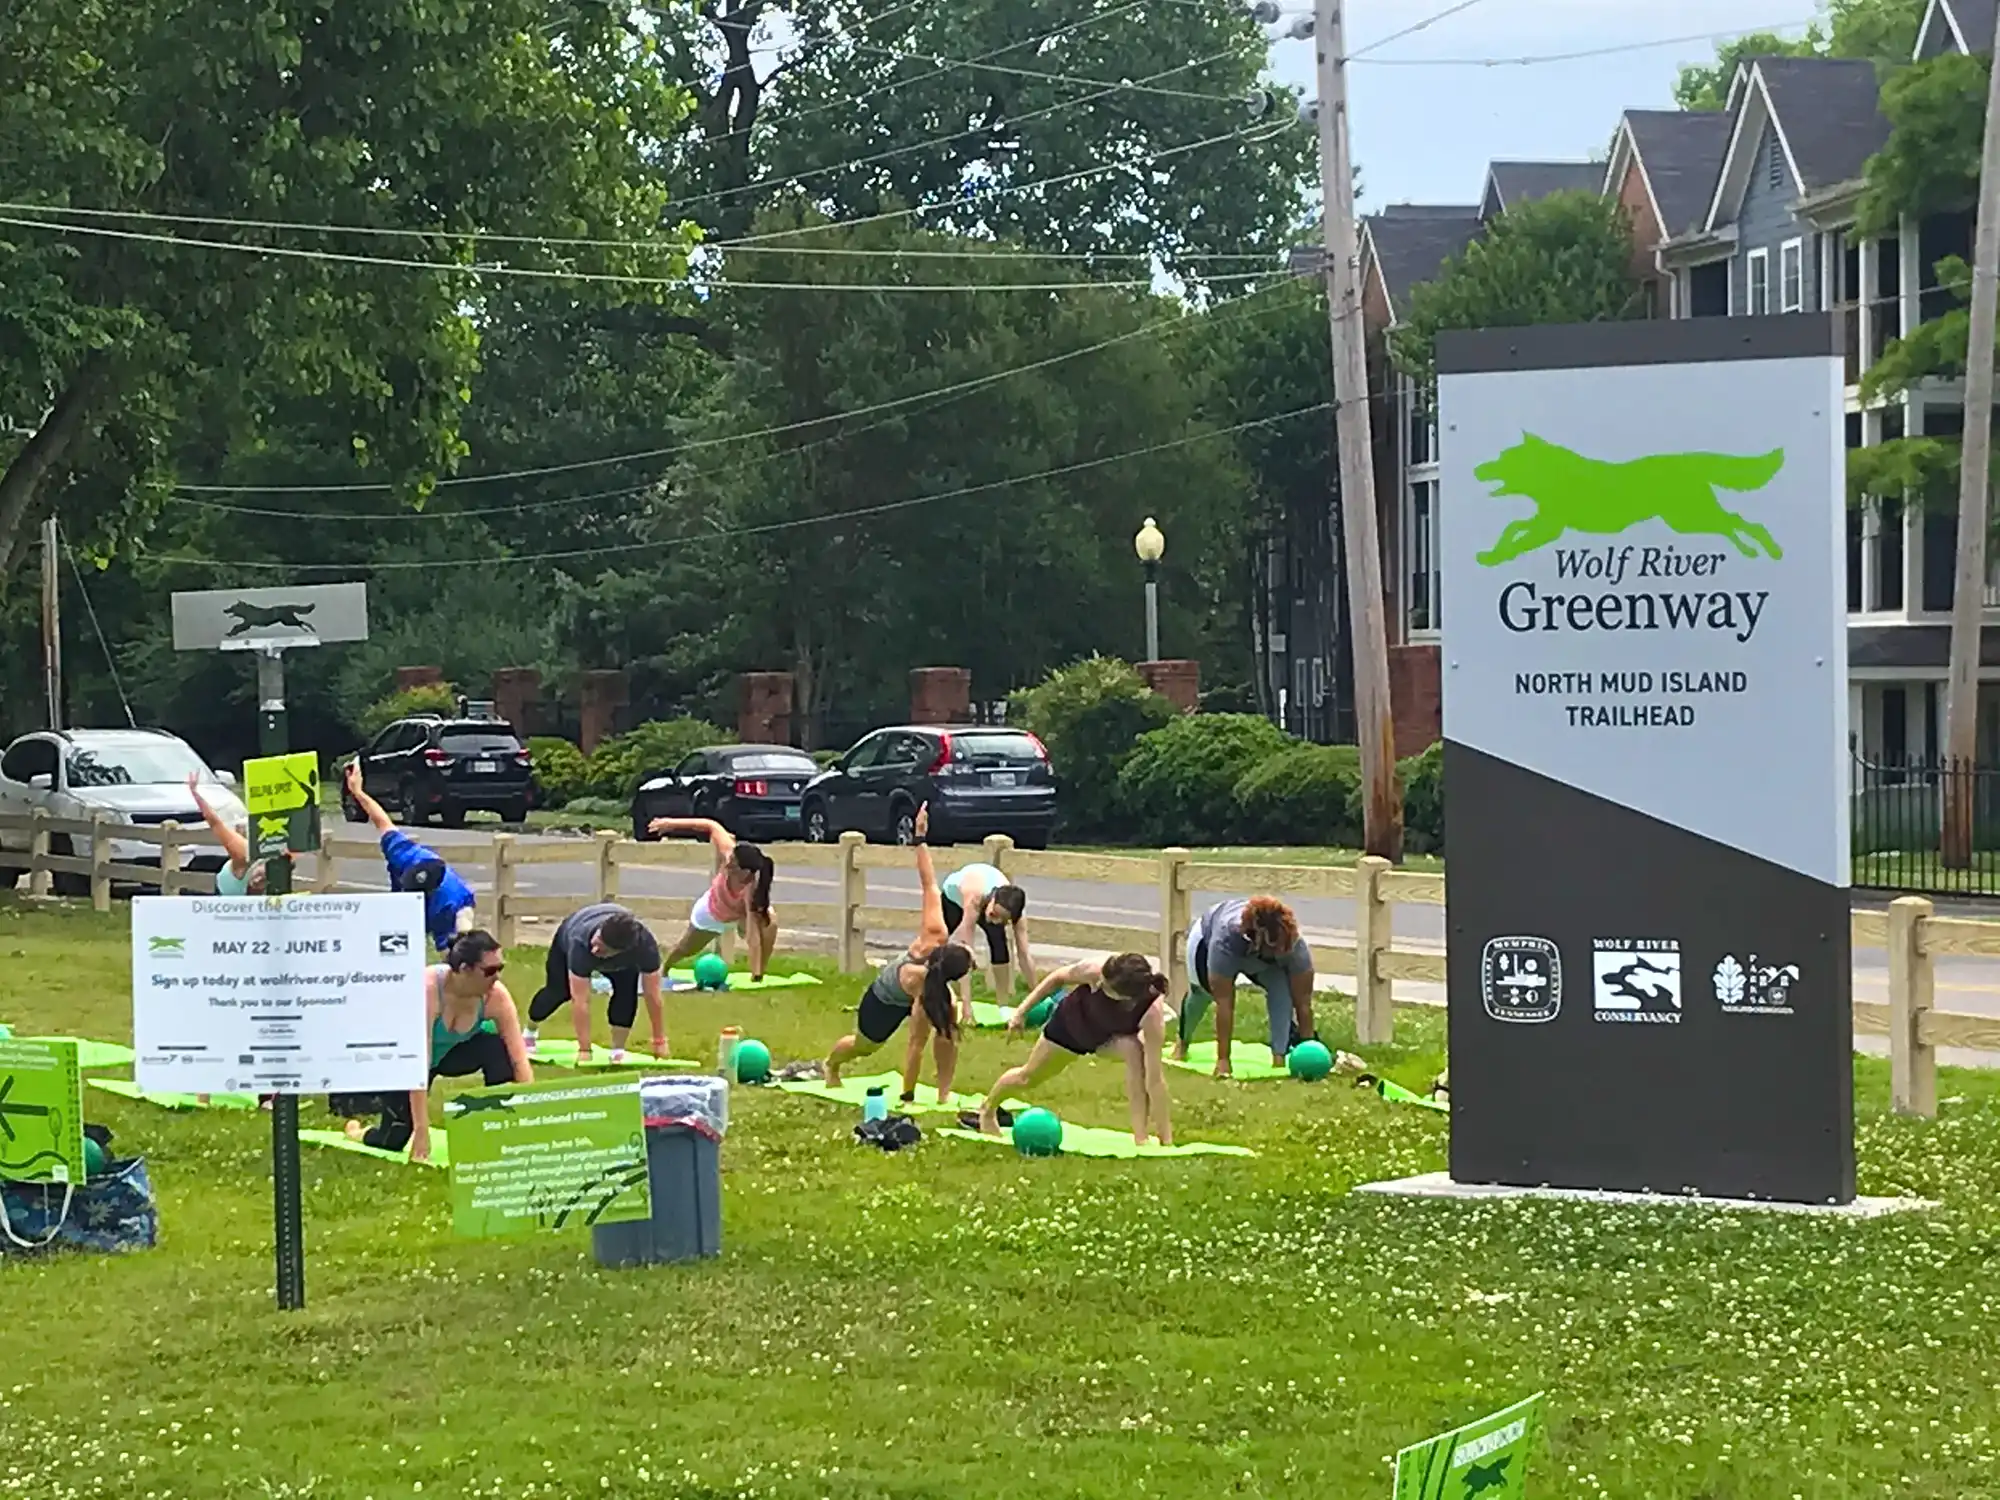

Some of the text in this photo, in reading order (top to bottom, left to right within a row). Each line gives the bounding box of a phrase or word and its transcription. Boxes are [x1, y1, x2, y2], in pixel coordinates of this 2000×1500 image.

[1555, 545, 1726, 585] Wolf River
[1499, 581, 1770, 642] Greenway
[1515, 671, 1748, 693] NORTH MUD ISLAND
[1565, 705, 1695, 727] TRAILHEAD
[191, 898, 361, 915] Discover the Greenway
[212, 941, 248, 955] MAY
[251, 940, 271, 954] 22
[284, 940, 328, 954] JUNE
[331, 939, 342, 953] 5
[1593, 938, 1680, 951] WOLF RIVER
[151, 971, 407, 989] Sign up today at wolfriver.org/discover
[208, 997, 238, 1008] Thank
[240, 998, 259, 1009] you
[261, 998, 273, 1007] to
[275, 998, 293, 1007] our
[1594, 1011, 1682, 1023] CONSERVANCY
